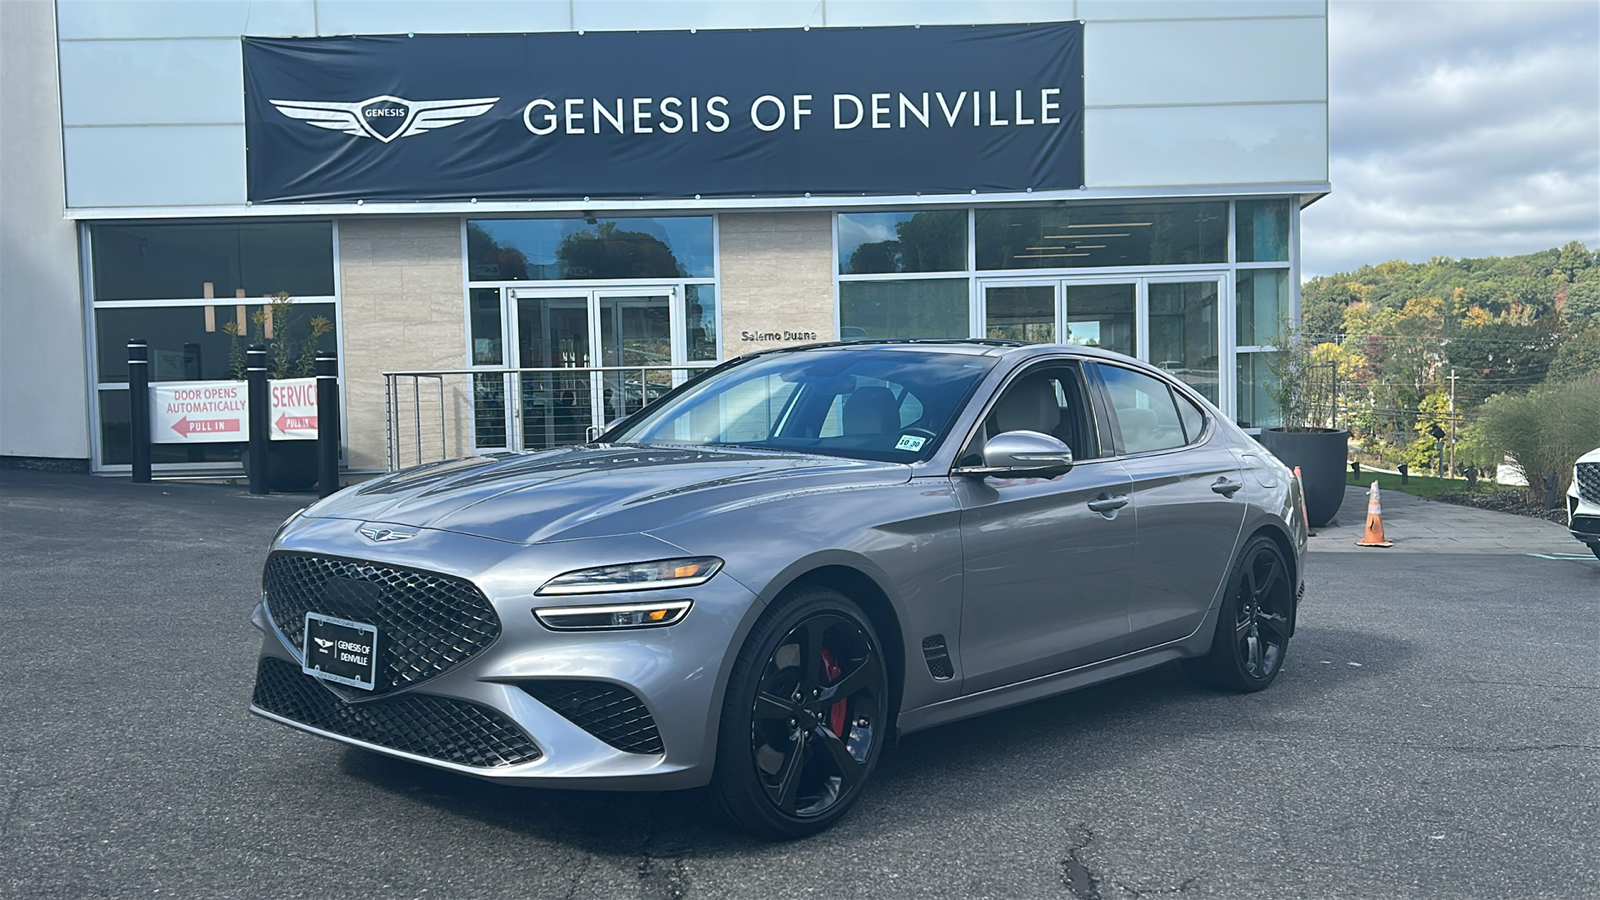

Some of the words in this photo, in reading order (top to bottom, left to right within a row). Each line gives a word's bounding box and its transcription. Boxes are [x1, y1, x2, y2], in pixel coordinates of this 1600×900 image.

[365, 108, 405, 117] GENESIS
[523, 96, 730, 136] GENESIS
[750, 94, 812, 132] OF
[833, 88, 1062, 130] DENVILLE
[741, 331, 781, 341] Salerno
[783, 331, 817, 341] Duane
[174, 390, 202, 400] DOOR
[204, 388, 237, 399] OPENS
[166, 400, 246, 413] AUTOMATICALLY
[189, 422, 211, 431] PULL
[215, 421, 225, 430] IN
[286, 418, 301, 428] PULL
[337, 640, 361, 653] GENESIS
[361, 645, 370, 655] OF
[340, 652, 368, 666] DENVILLE
